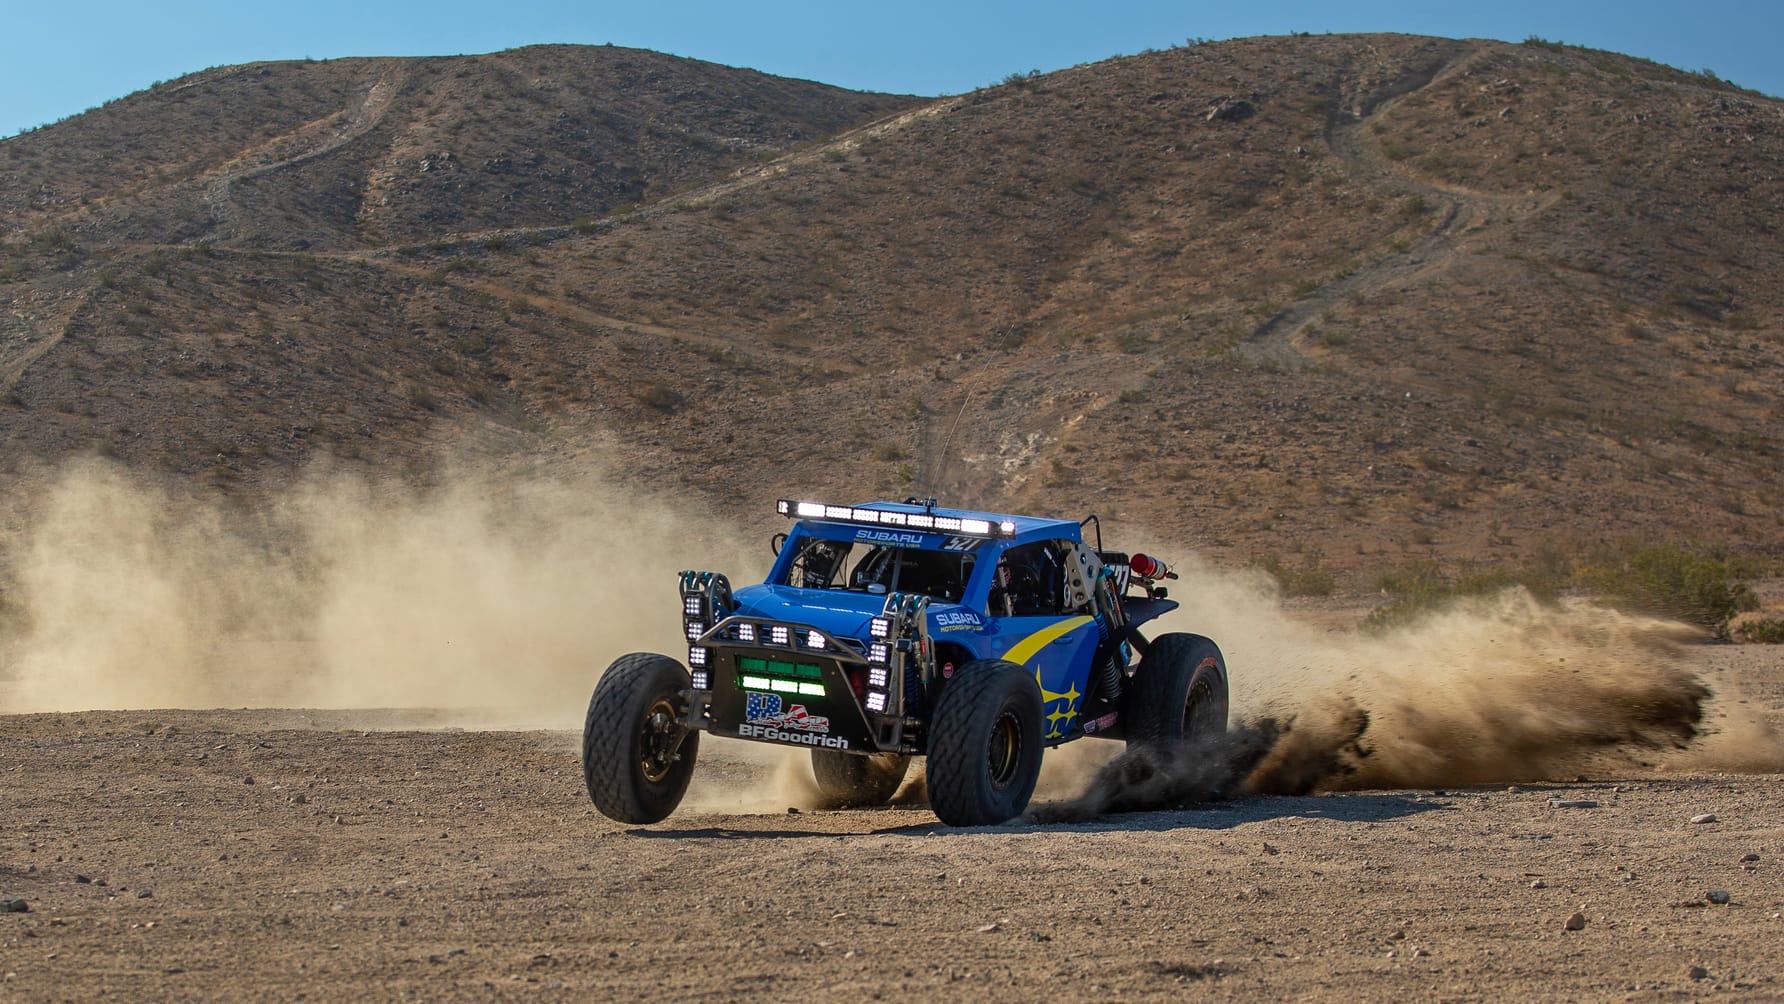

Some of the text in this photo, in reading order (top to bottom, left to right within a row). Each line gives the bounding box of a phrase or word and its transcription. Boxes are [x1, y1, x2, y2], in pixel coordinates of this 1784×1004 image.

[855, 529, 923, 543] SUBARU
[935, 612, 981, 626] SUBARU
[739, 723, 849, 750] BFGoodrich
